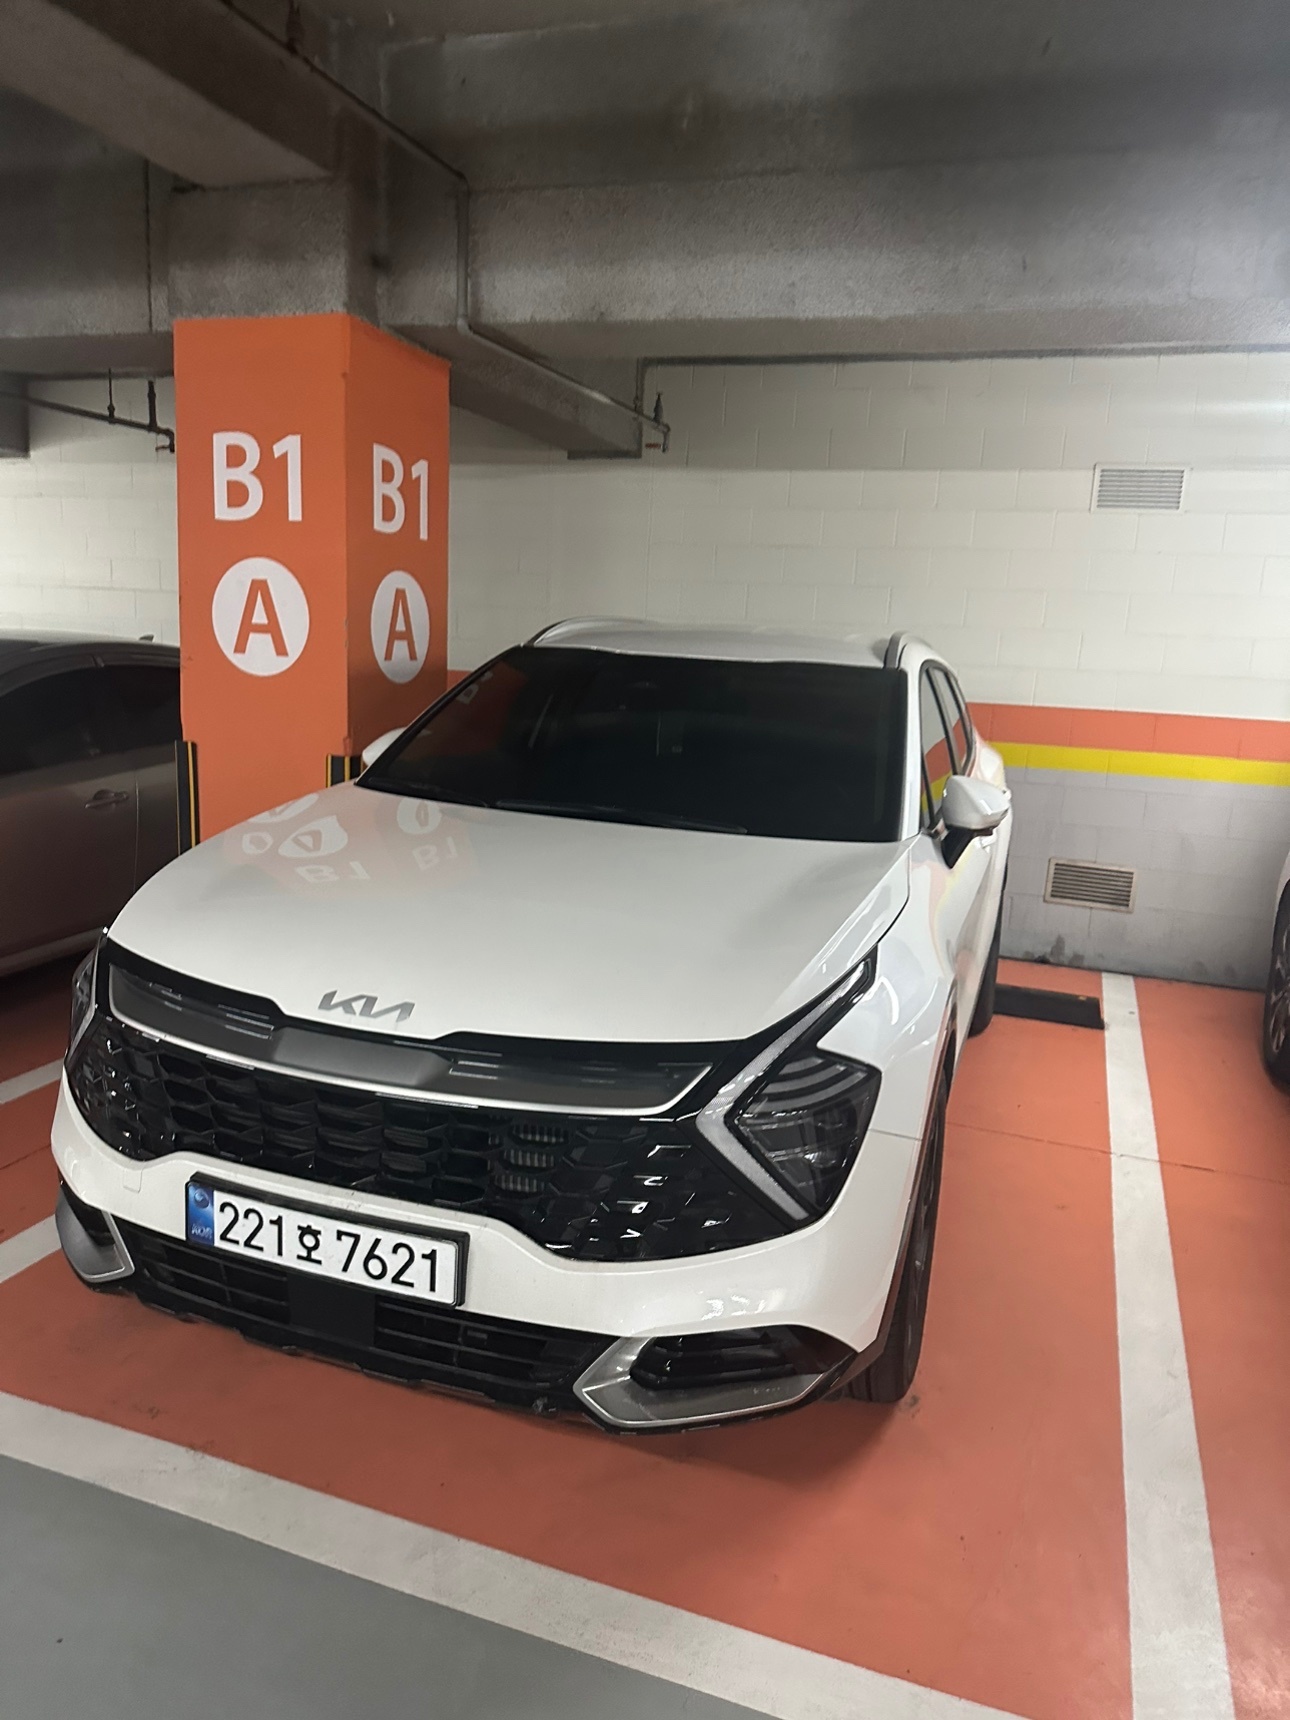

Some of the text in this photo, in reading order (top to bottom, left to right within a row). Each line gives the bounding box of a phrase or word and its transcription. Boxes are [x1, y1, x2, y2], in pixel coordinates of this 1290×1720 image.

[212, 431, 302, 522] B1
[373, 442, 429, 541] B1
[233, 578, 289, 657] A
[384, 587, 418, 662] A
[318, 990, 415, 1022] KIA
